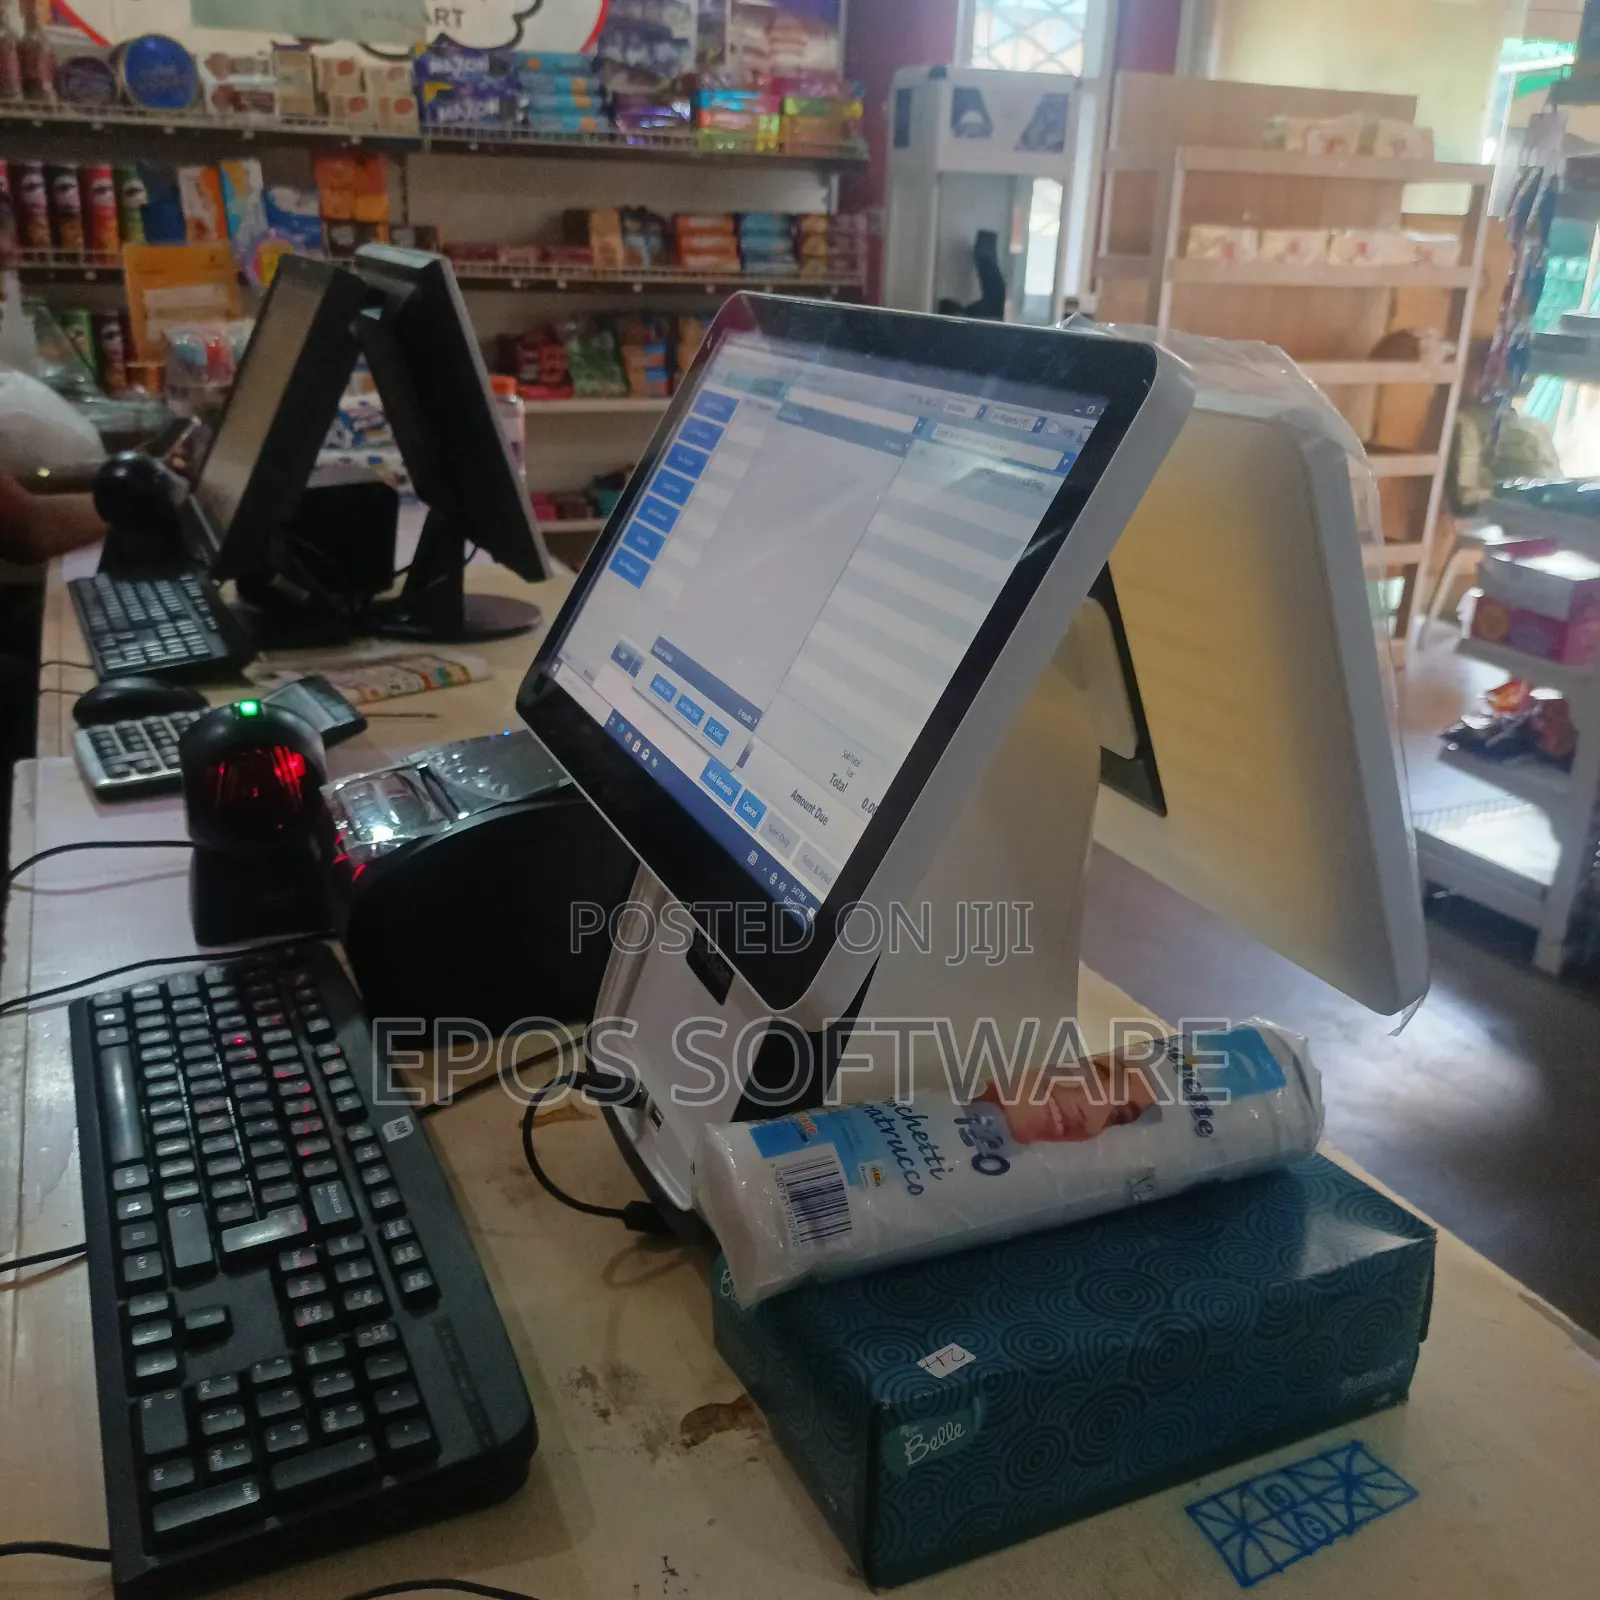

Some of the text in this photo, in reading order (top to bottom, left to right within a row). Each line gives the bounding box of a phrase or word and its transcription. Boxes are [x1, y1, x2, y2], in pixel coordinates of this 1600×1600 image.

[829, 772, 849, 793] Total
[742, 801, 759, 819] Cancel
[790, 788, 829, 826] Amount Due
[801, 854, 814, 868] Save
[904, 1421, 967, 1466] Belle
